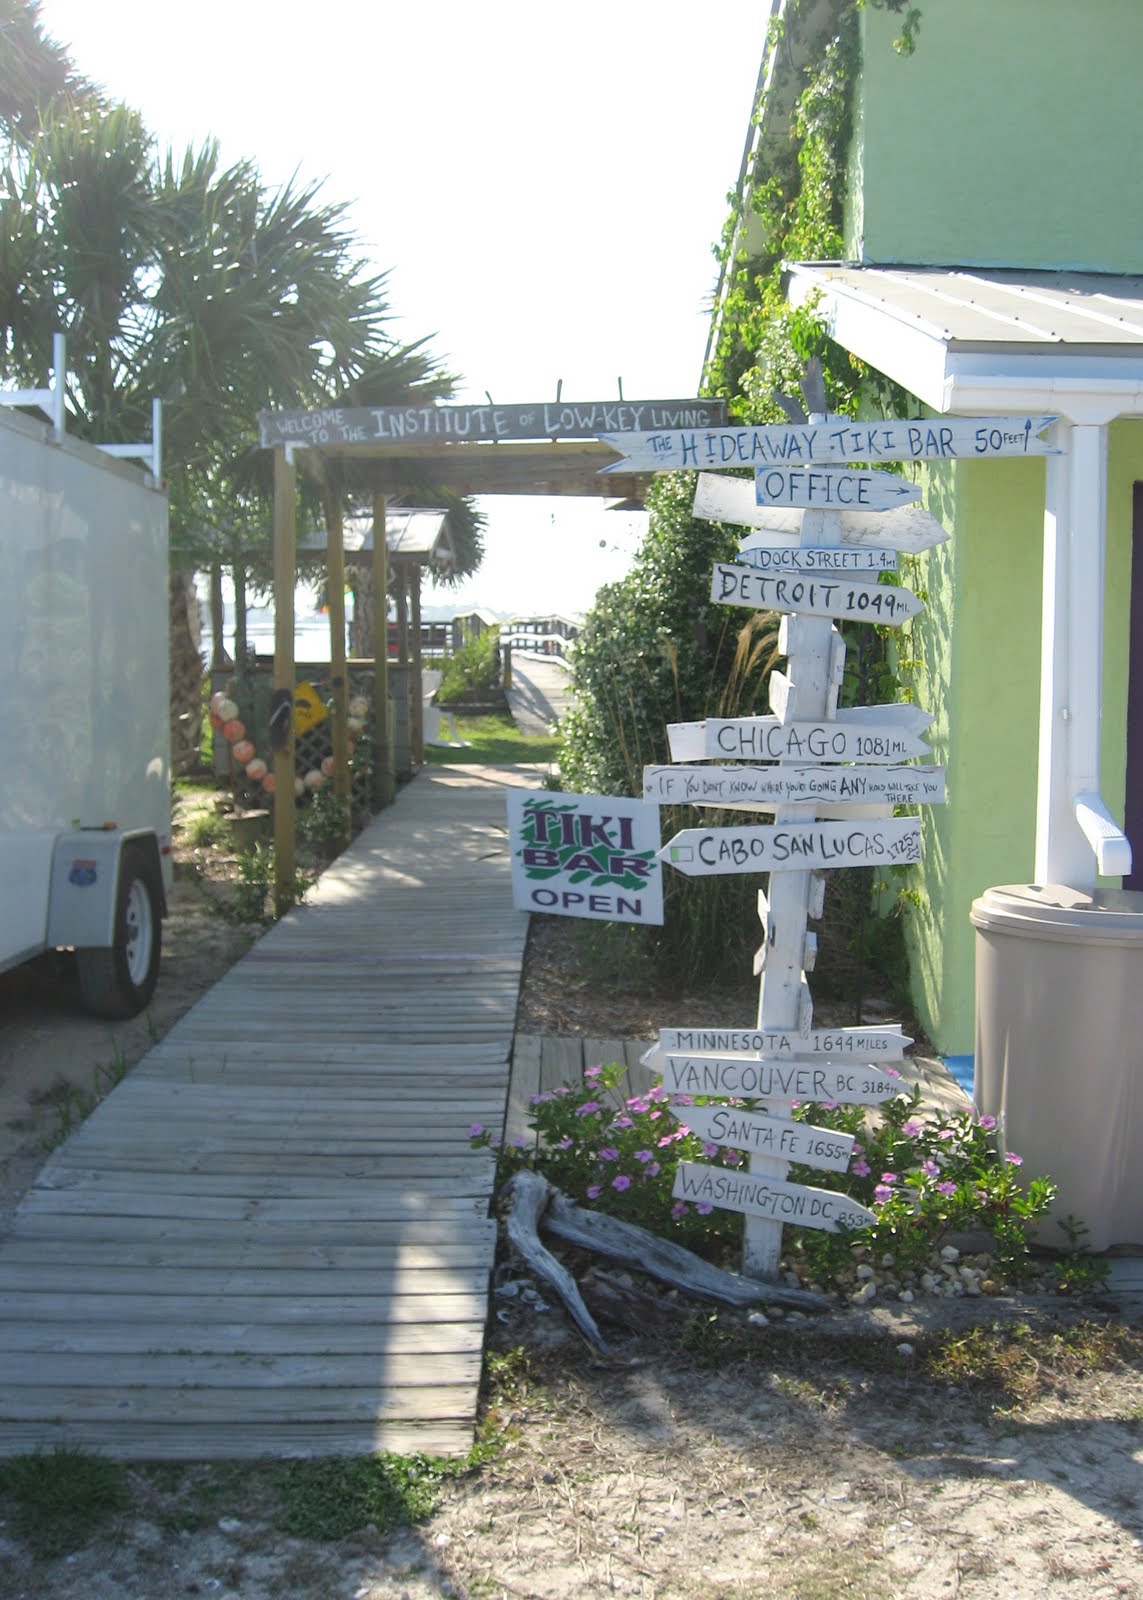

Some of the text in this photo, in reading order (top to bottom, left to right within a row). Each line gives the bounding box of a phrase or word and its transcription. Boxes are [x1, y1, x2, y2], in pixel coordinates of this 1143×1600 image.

[276, 409, 344, 433] WELCOME
[309, 424, 368, 443] TO THE
[371, 403, 710, 437] INSTITUTE OF LOW-KEY LIVING
[647, 435, 673, 453] THE
[681, 429, 819, 466] HIDEAWAY
[833, 427, 896, 451] TIKI
[908, 428, 957, 456] BAR
[765, 472, 873, 504] OFFICE
[760, 551, 801, 568] DOCK
[805, 551, 861, 568] STREET
[718, 566, 840, 608] DETROIT
[717, 725, 847, 758] CHICAGO
[659, 777, 675, 795] IF
[684, 775, 700, 798] YOU
[729, 780, 757, 796] KNOW
[809, 779, 837, 794] GOING
[840, 777, 867, 797] ANY
[887, 782, 903, 793] WILL
[923, 782, 938, 795] YOU
[884, 793, 913, 803] THERE
[523, 809, 635, 850] TIKI
[523, 849, 651, 877] BAR
[698, 836, 764, 867] CABO
[772, 832, 815, 861] SAN
[820, 830, 884, 860] LUCAS
[531, 889, 642, 916] OPEN
[676, 1032, 791, 1051] MINNESOTA
[856, 1038, 888, 1050] MILES
[670, 1059, 834, 1099] VANCOUVER
[707, 1111, 773, 1149] SANTA
[780, 1129, 799, 1154] FE
[680, 1167, 806, 1216] WASHINGTON
